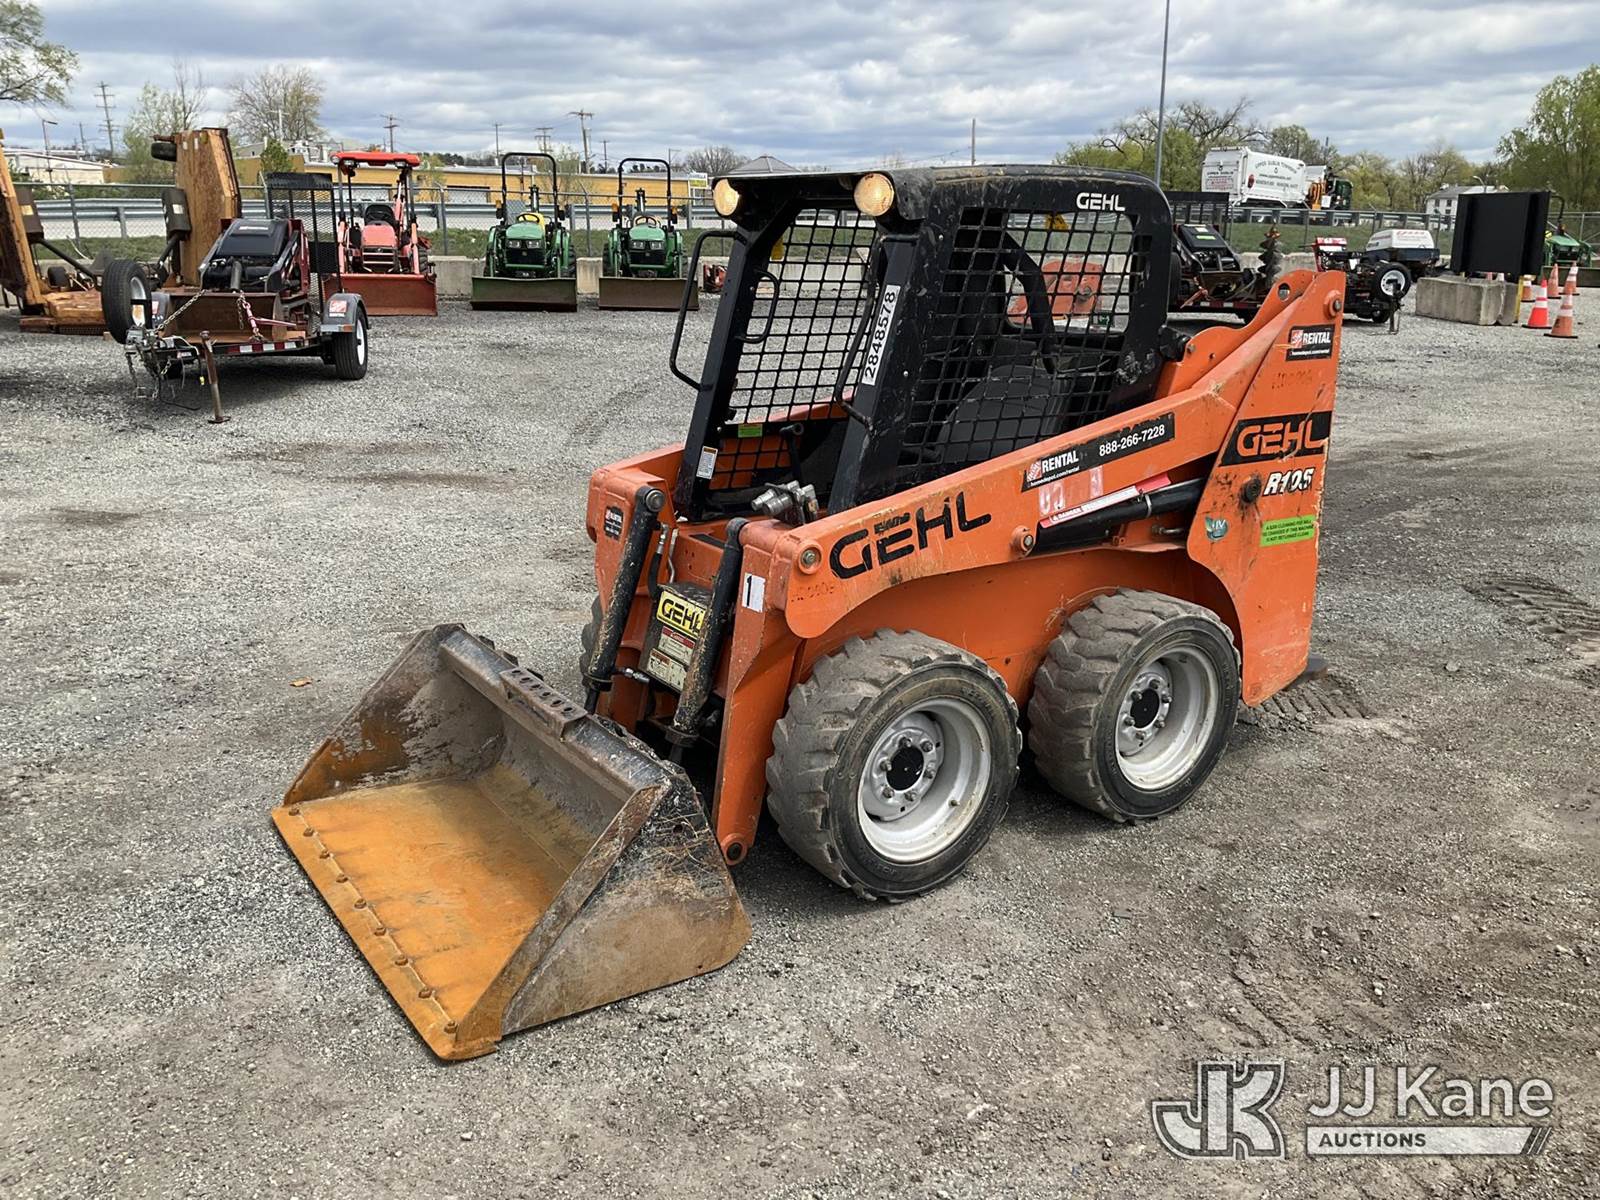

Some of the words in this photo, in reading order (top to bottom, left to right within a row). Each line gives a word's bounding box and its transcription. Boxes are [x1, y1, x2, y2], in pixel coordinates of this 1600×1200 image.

[1076, 192, 1126, 211] GEHL
[864, 291, 896, 379] 2848578
[1302, 331, 1331, 346] RENTAL
[1099, 424, 1165, 457] 888-266-7228
[1237, 420, 1327, 457] GEHL
[1041, 450, 1079, 474] RENTAL
[829, 491, 992, 579] GEHL
[661, 598, 706, 635] GEHL
